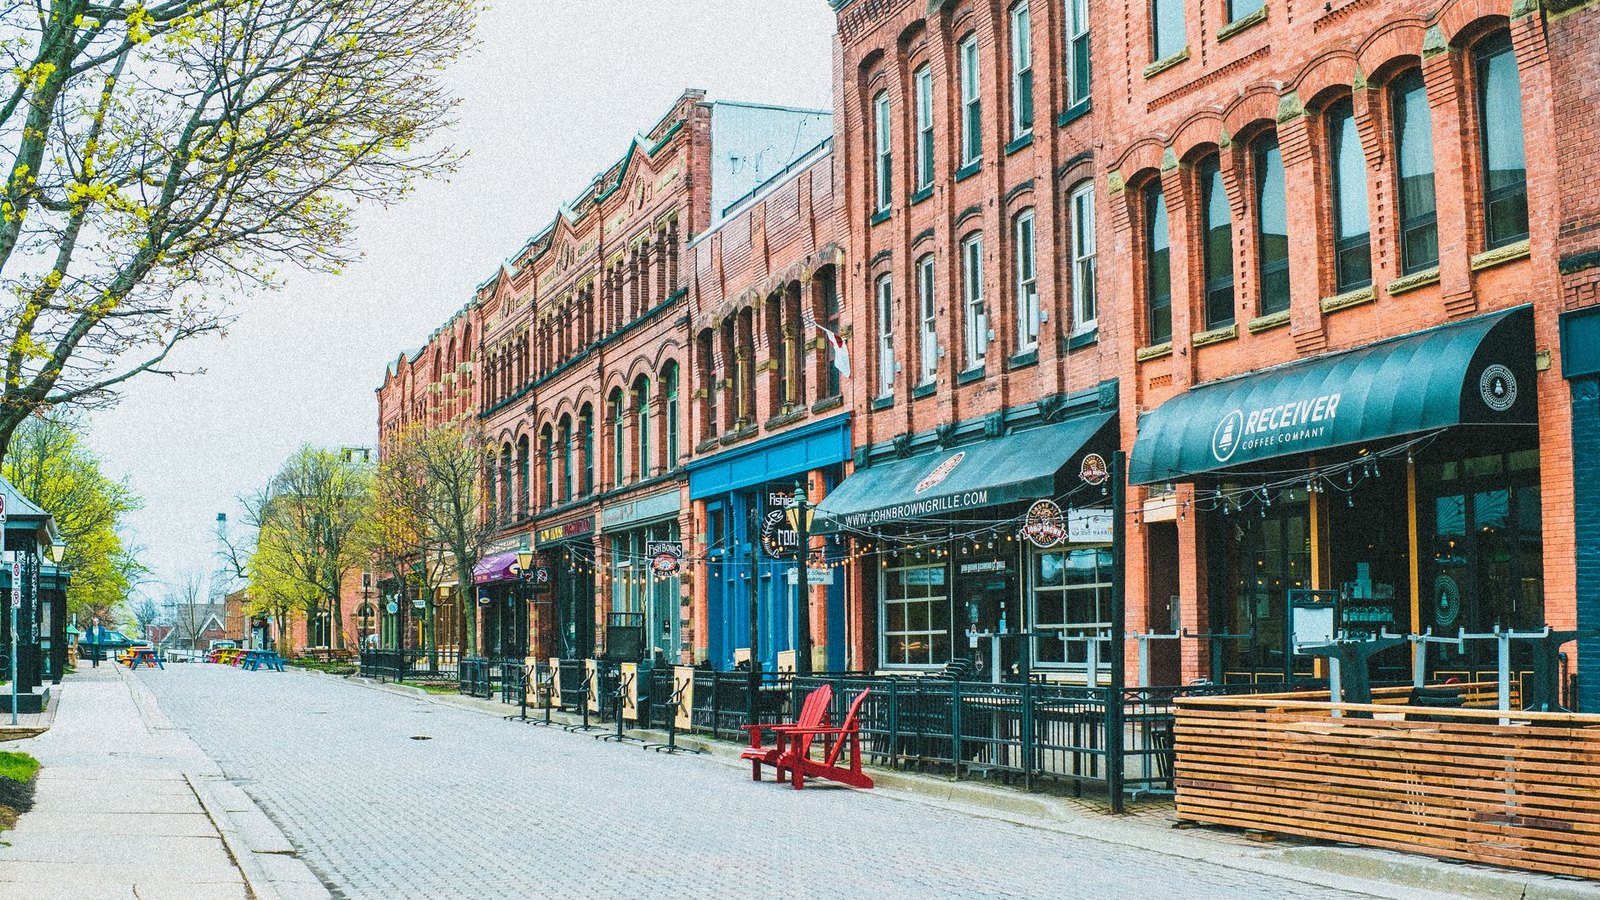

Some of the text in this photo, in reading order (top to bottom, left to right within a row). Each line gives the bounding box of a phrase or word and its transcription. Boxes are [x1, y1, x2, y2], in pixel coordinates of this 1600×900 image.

[1245, 393, 1341, 436] RECEIVER
[1242, 426, 1325, 451] COFFEE COMPANY
[845, 490, 988, 527] WWW.JOHNBROWNGRILLE.COM
